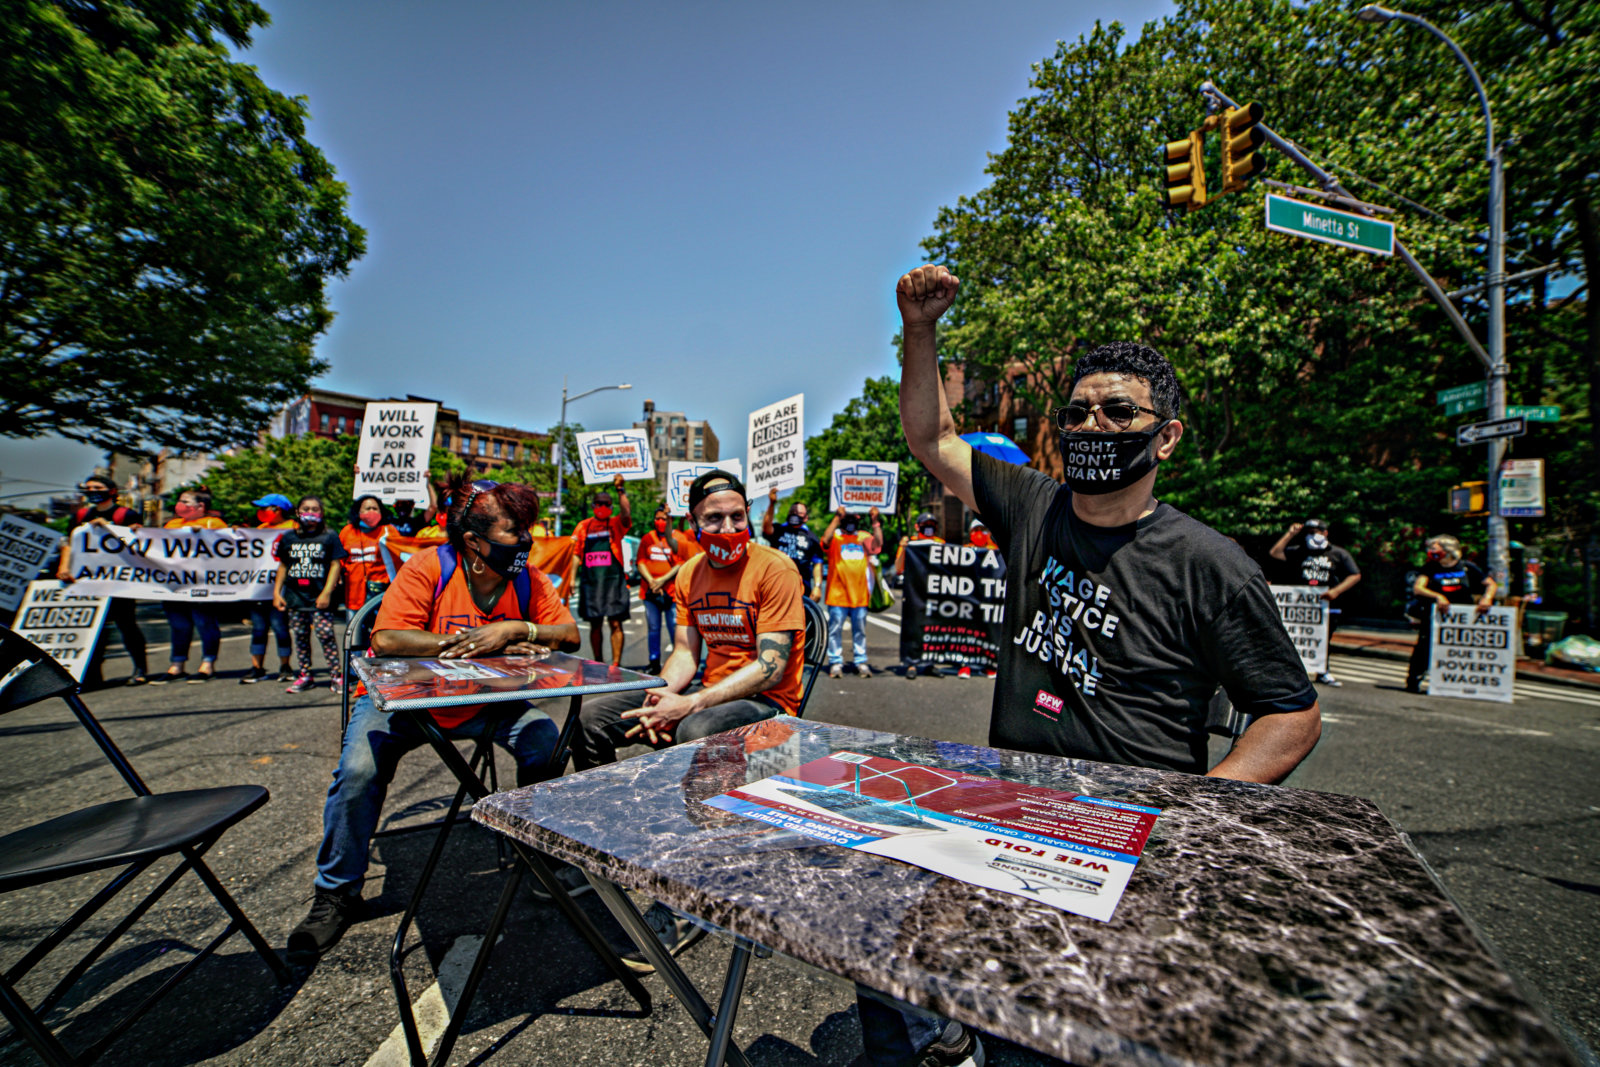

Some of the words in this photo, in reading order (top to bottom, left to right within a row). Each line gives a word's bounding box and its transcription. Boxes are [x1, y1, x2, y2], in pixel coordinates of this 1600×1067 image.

[1303, 211, 1343, 236] Minetta
[1347, 222, 1359, 239] St
[379, 410, 420, 422] WILL
[753, 413, 771, 428] WE
[774, 403, 798, 421] ARE
[1508, 408, 1545, 420] Minetta
[370, 425, 424, 438] WORK
[754, 418, 797, 447] CLOSED
[1496, 423, 1517, 432] WAY
[384, 441, 406, 449] FOR
[594, 447, 614, 455] NEW
[614, 445, 636, 454] YORK
[758, 445, 775, 457] DUE
[777, 440, 791, 450] TO
[369, 453, 416, 468] FAIR
[597, 458, 639, 471] CHANGE
[751, 449, 797, 472] POVERTY
[1069, 452, 1117, 466] DON'T
[361, 470, 421, 483] WAGES!
[755, 463, 794, 483] WAGES
[1067, 465, 1121, 480] STARVE
[845, 478, 863, 486] NEW
[844, 491, 883, 502] CHANGE
[0, 521, 26, 537] WE
[25, 531, 54, 547] ARE
[82, 532, 152, 558] LOW
[162, 538, 264, 558] WAGES
[709, 543, 742, 560] NYCC
[289, 550, 325, 558] USTICE
[929, 545, 977, 566] END
[981, 549, 999, 569] A
[76, 565, 197, 585] AMERICAN
[205, 569, 277, 585] RECOVER
[1038, 556, 1111, 608] WAGE
[927, 574, 975, 596] END
[980, 578, 1007, 599] TH
[32, 589, 62, 602] WE
[1296, 594, 1320, 604] ARE
[925, 599, 974, 619] FOR
[980, 603, 1005, 624] TI
[1045, 581, 1119, 638] STICE
[24, 607, 95, 628] CLOSED
[697, 613, 718, 625] NEW
[719, 613, 744, 626] YORK
[1052, 610, 1073, 636] IS
[1441, 612, 1468, 624] WE
[1473, 614, 1510, 627] ARE
[1299, 626, 1315, 635] TO
[57, 633, 78, 643] TO
[923, 634, 1000, 651] OneFairWage.
[1293, 637, 1322, 648] ERTY
[1441, 628, 1506, 648] CLOSED
[950, 644, 981, 654] FIGHT
[1447, 649, 1473, 659] DUE
[1478, 651, 1498, 660] TO
[1013, 626, 1099, 696] JUSTICE
[1436, 660, 1507, 674] POVERTY
[1442, 673, 1501, 686] WAGES
[1039, 693, 1062, 708] OFW
[744, 811, 783, 825] UTILITY
[767, 811, 803, 824] TABLE
[977, 814, 1001, 822] TABLE
[1021, 806, 1057, 817] COATING
[1003, 820, 1053, 833] ADDITIONAL
[1022, 815, 1059, 826] DURABLE
[1075, 818, 1134, 832] WATERPROOF
[784, 822, 848, 844] OVERSIZED
[805, 822, 863, 841] FOLDING
[989, 827, 1018, 836] GRAN
[1067, 833, 1098, 844] USEFUL
[1081, 828, 1130, 840] OVERSIZED
[984, 838, 1046, 857] FOLD
[1038, 837, 1084, 851] PLEGABLE
[1101, 841, 1124, 849] VERY
[1086, 848, 1116, 858] MESA
[992, 861, 1047, 878] BEYOND
[1054, 854, 1110, 873] WEE
[1052, 876, 1098, 892] WEE'S
